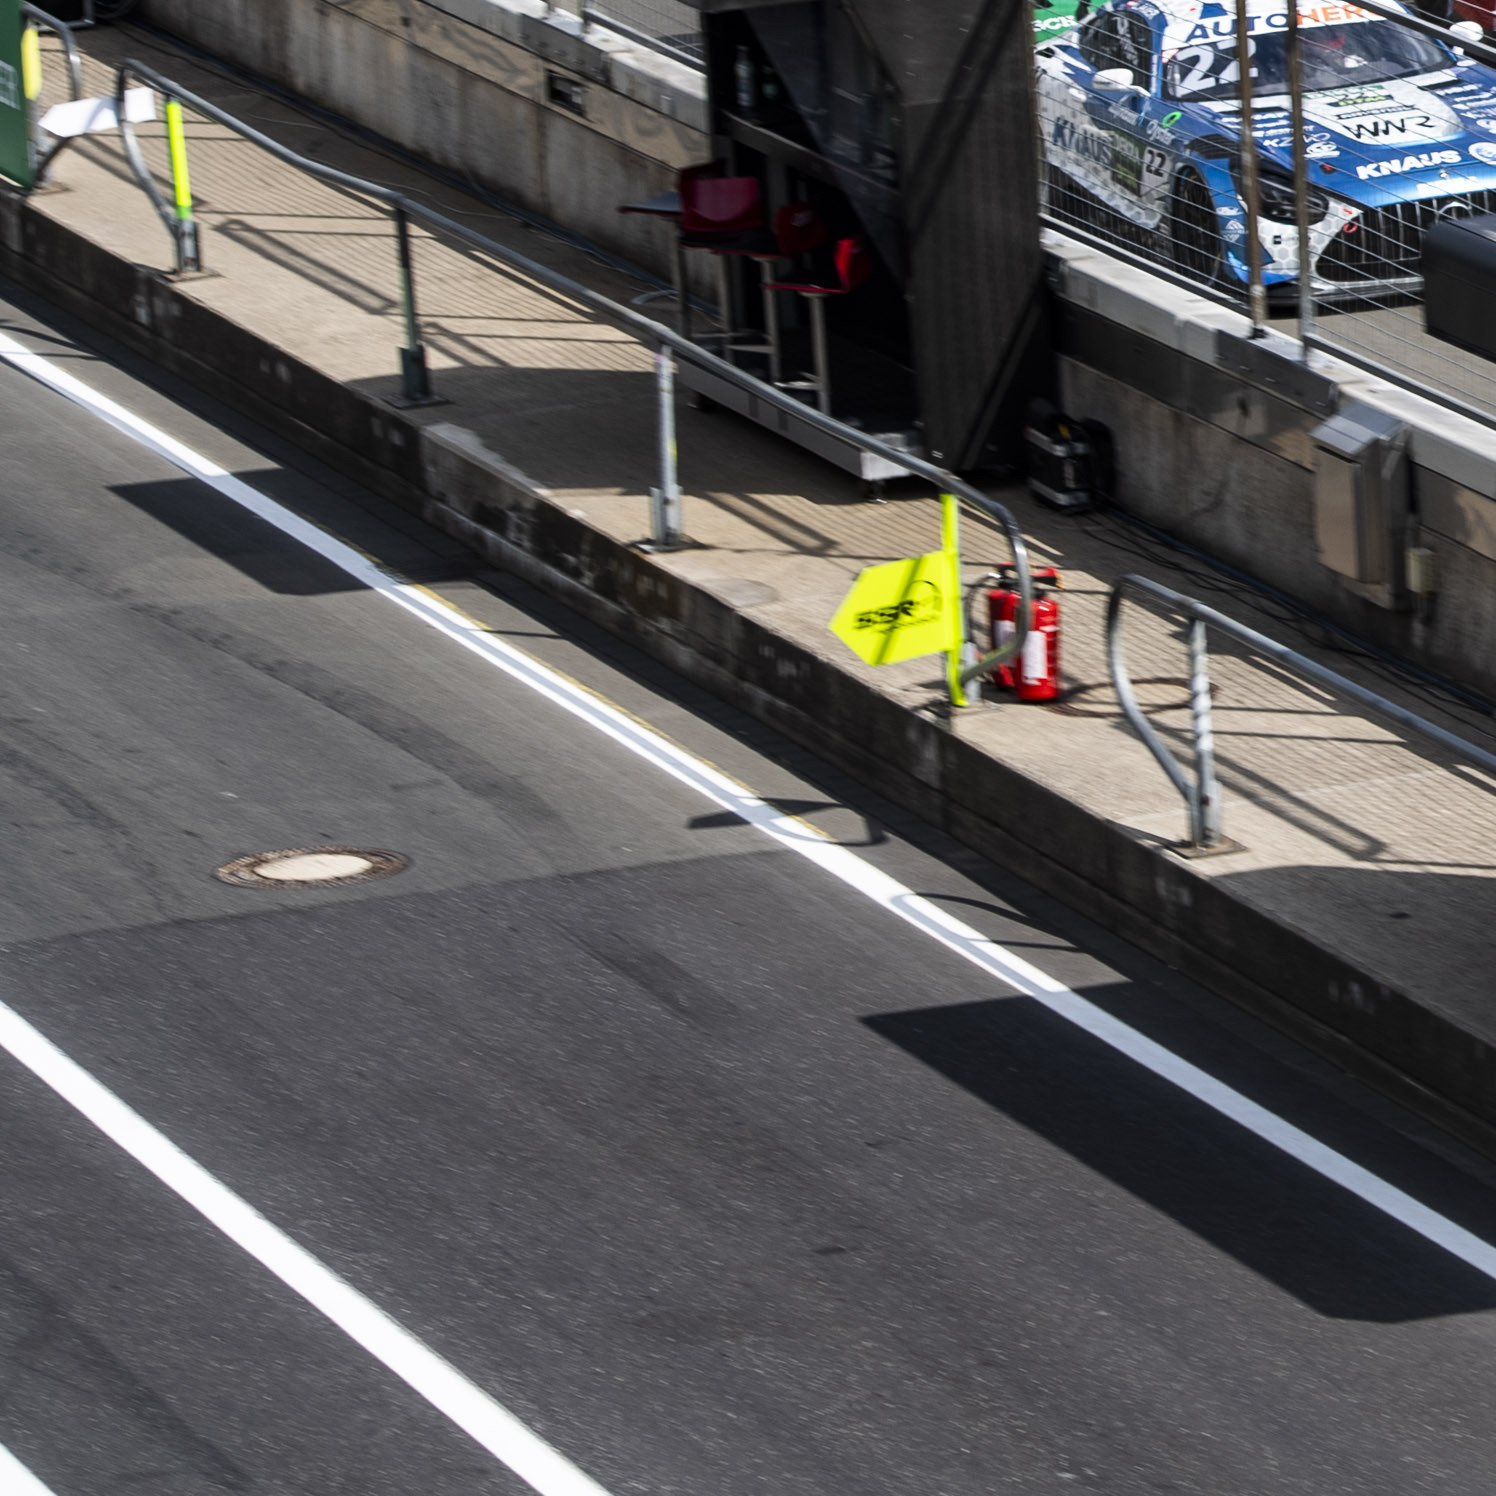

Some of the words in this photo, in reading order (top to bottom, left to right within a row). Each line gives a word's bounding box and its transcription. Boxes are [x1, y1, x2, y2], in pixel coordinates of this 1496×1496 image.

[1174, 37, 1260, 99] 22
[1144, 148, 1168, 178] 22
[1355, 149, 1463, 181] KNAUS
